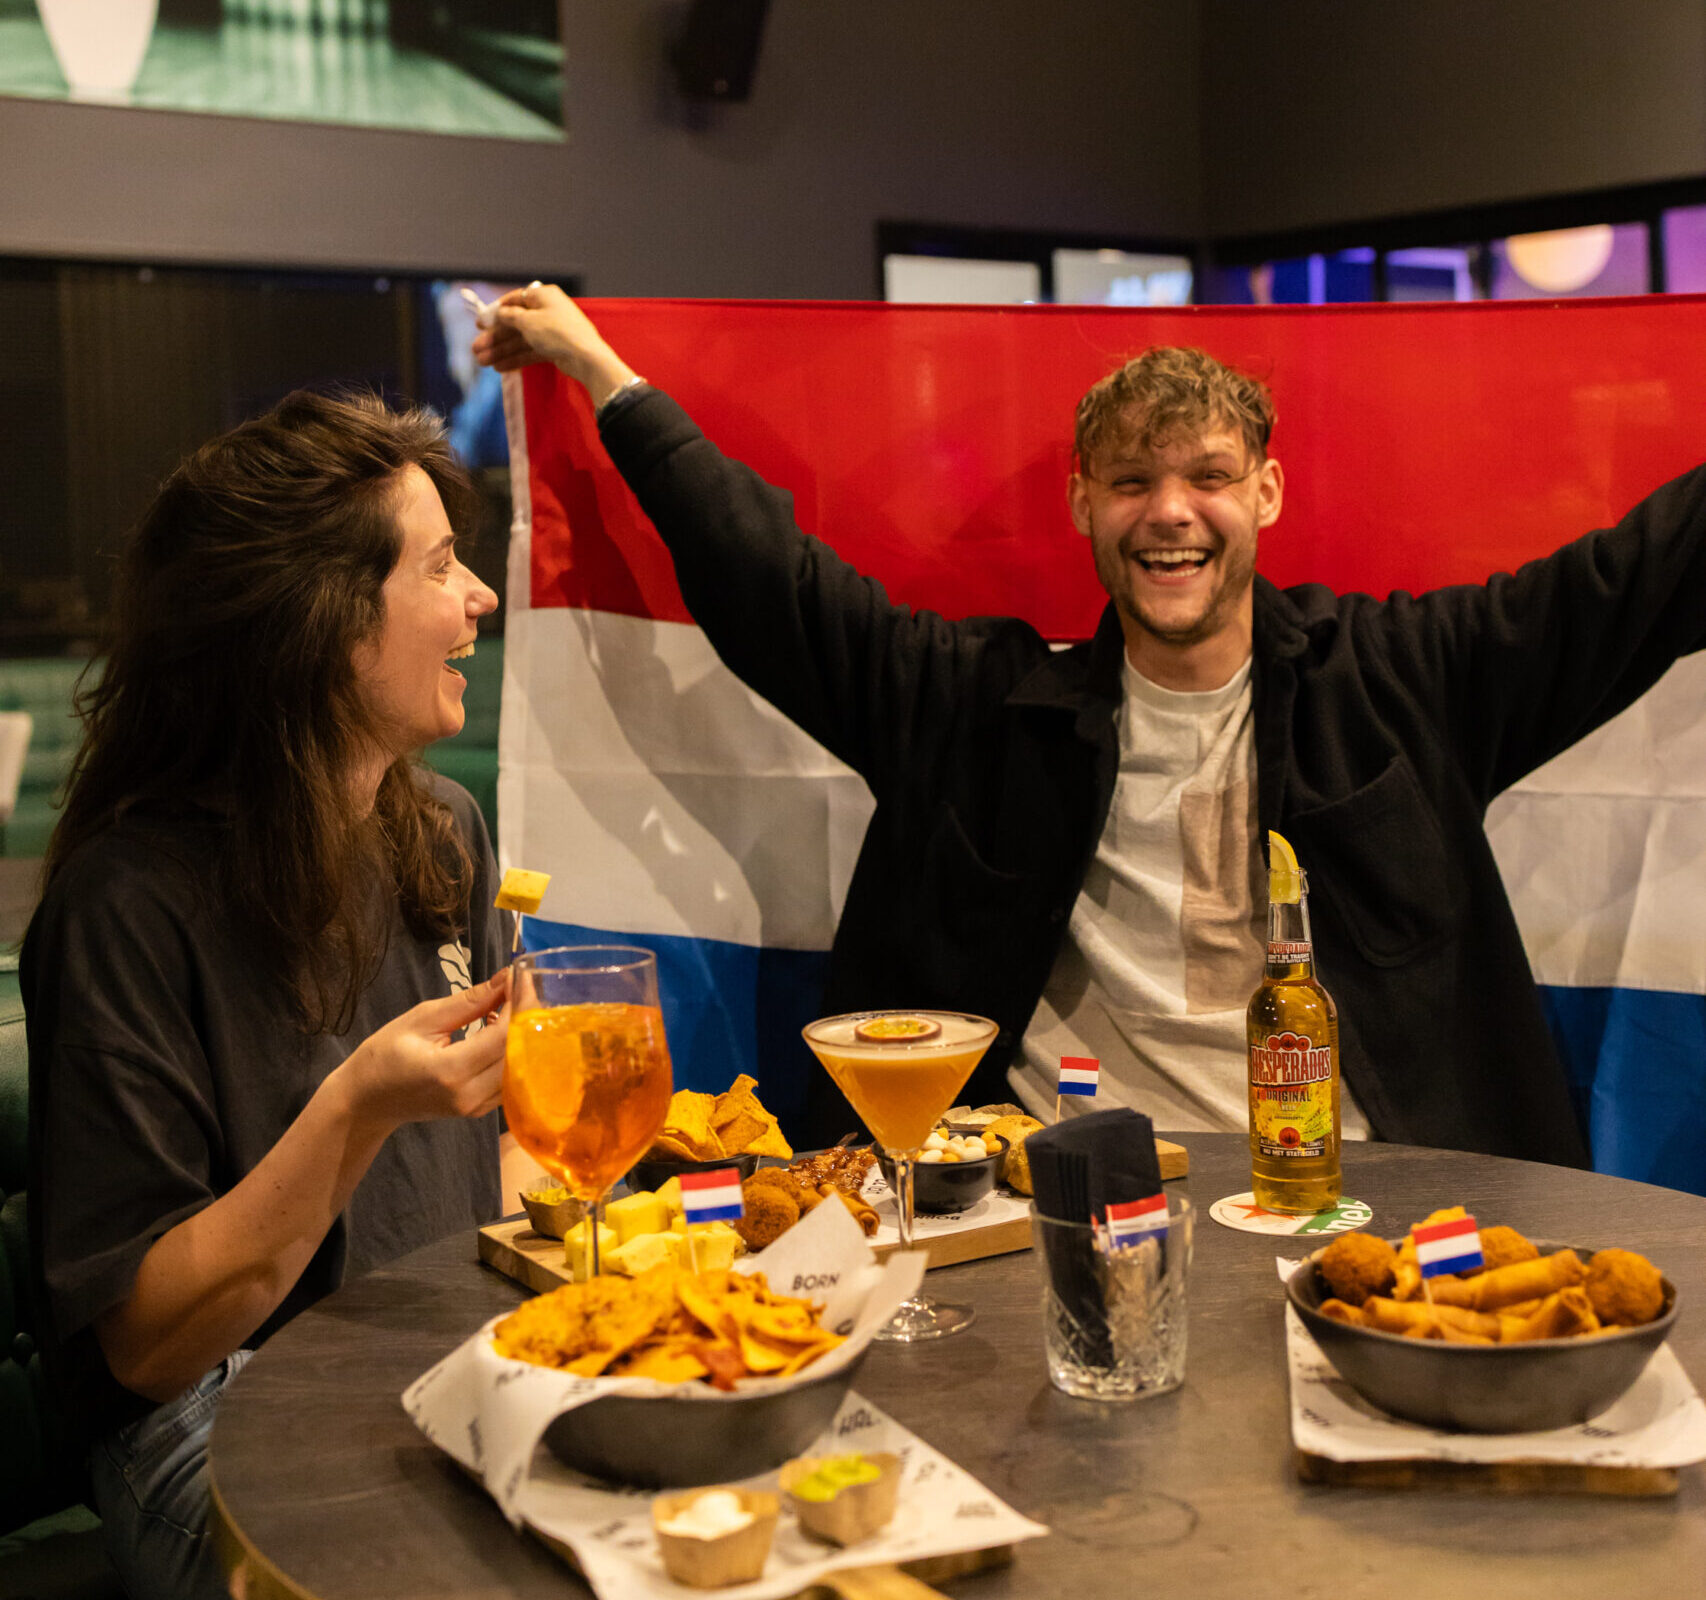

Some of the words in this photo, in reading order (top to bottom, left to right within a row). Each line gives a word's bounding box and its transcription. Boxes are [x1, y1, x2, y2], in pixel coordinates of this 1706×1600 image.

[1252, 1048, 1331, 1083] DESPERADOS
[1266, 1088, 1312, 1102] ORIGINAL
[792, 1273, 841, 1291] BORN
